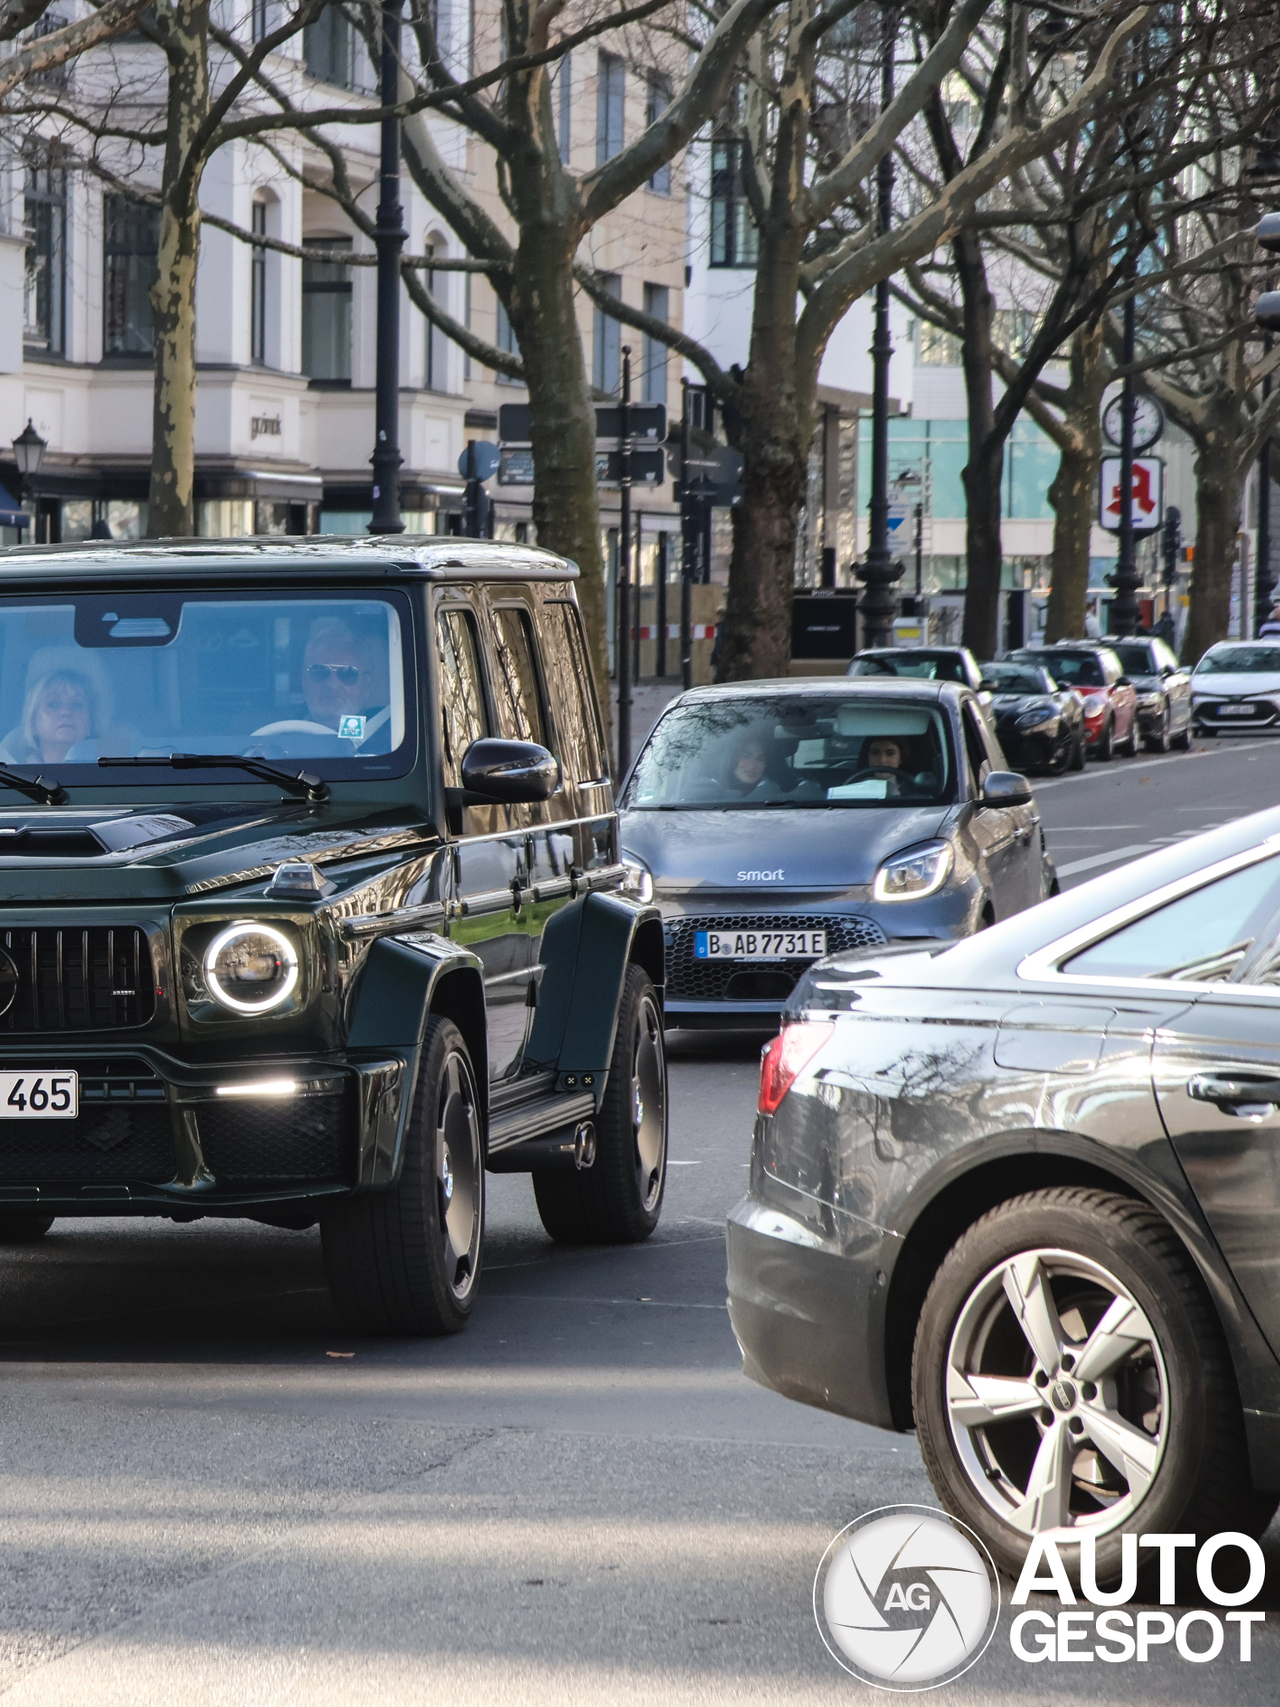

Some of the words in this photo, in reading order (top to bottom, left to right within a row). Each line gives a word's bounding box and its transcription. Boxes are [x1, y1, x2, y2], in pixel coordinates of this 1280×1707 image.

[736, 868, 786, 882] smart
[709, 933, 720, 955] B
[734, 933, 757, 955] AB
[7, 1078, 71, 1112] 465
